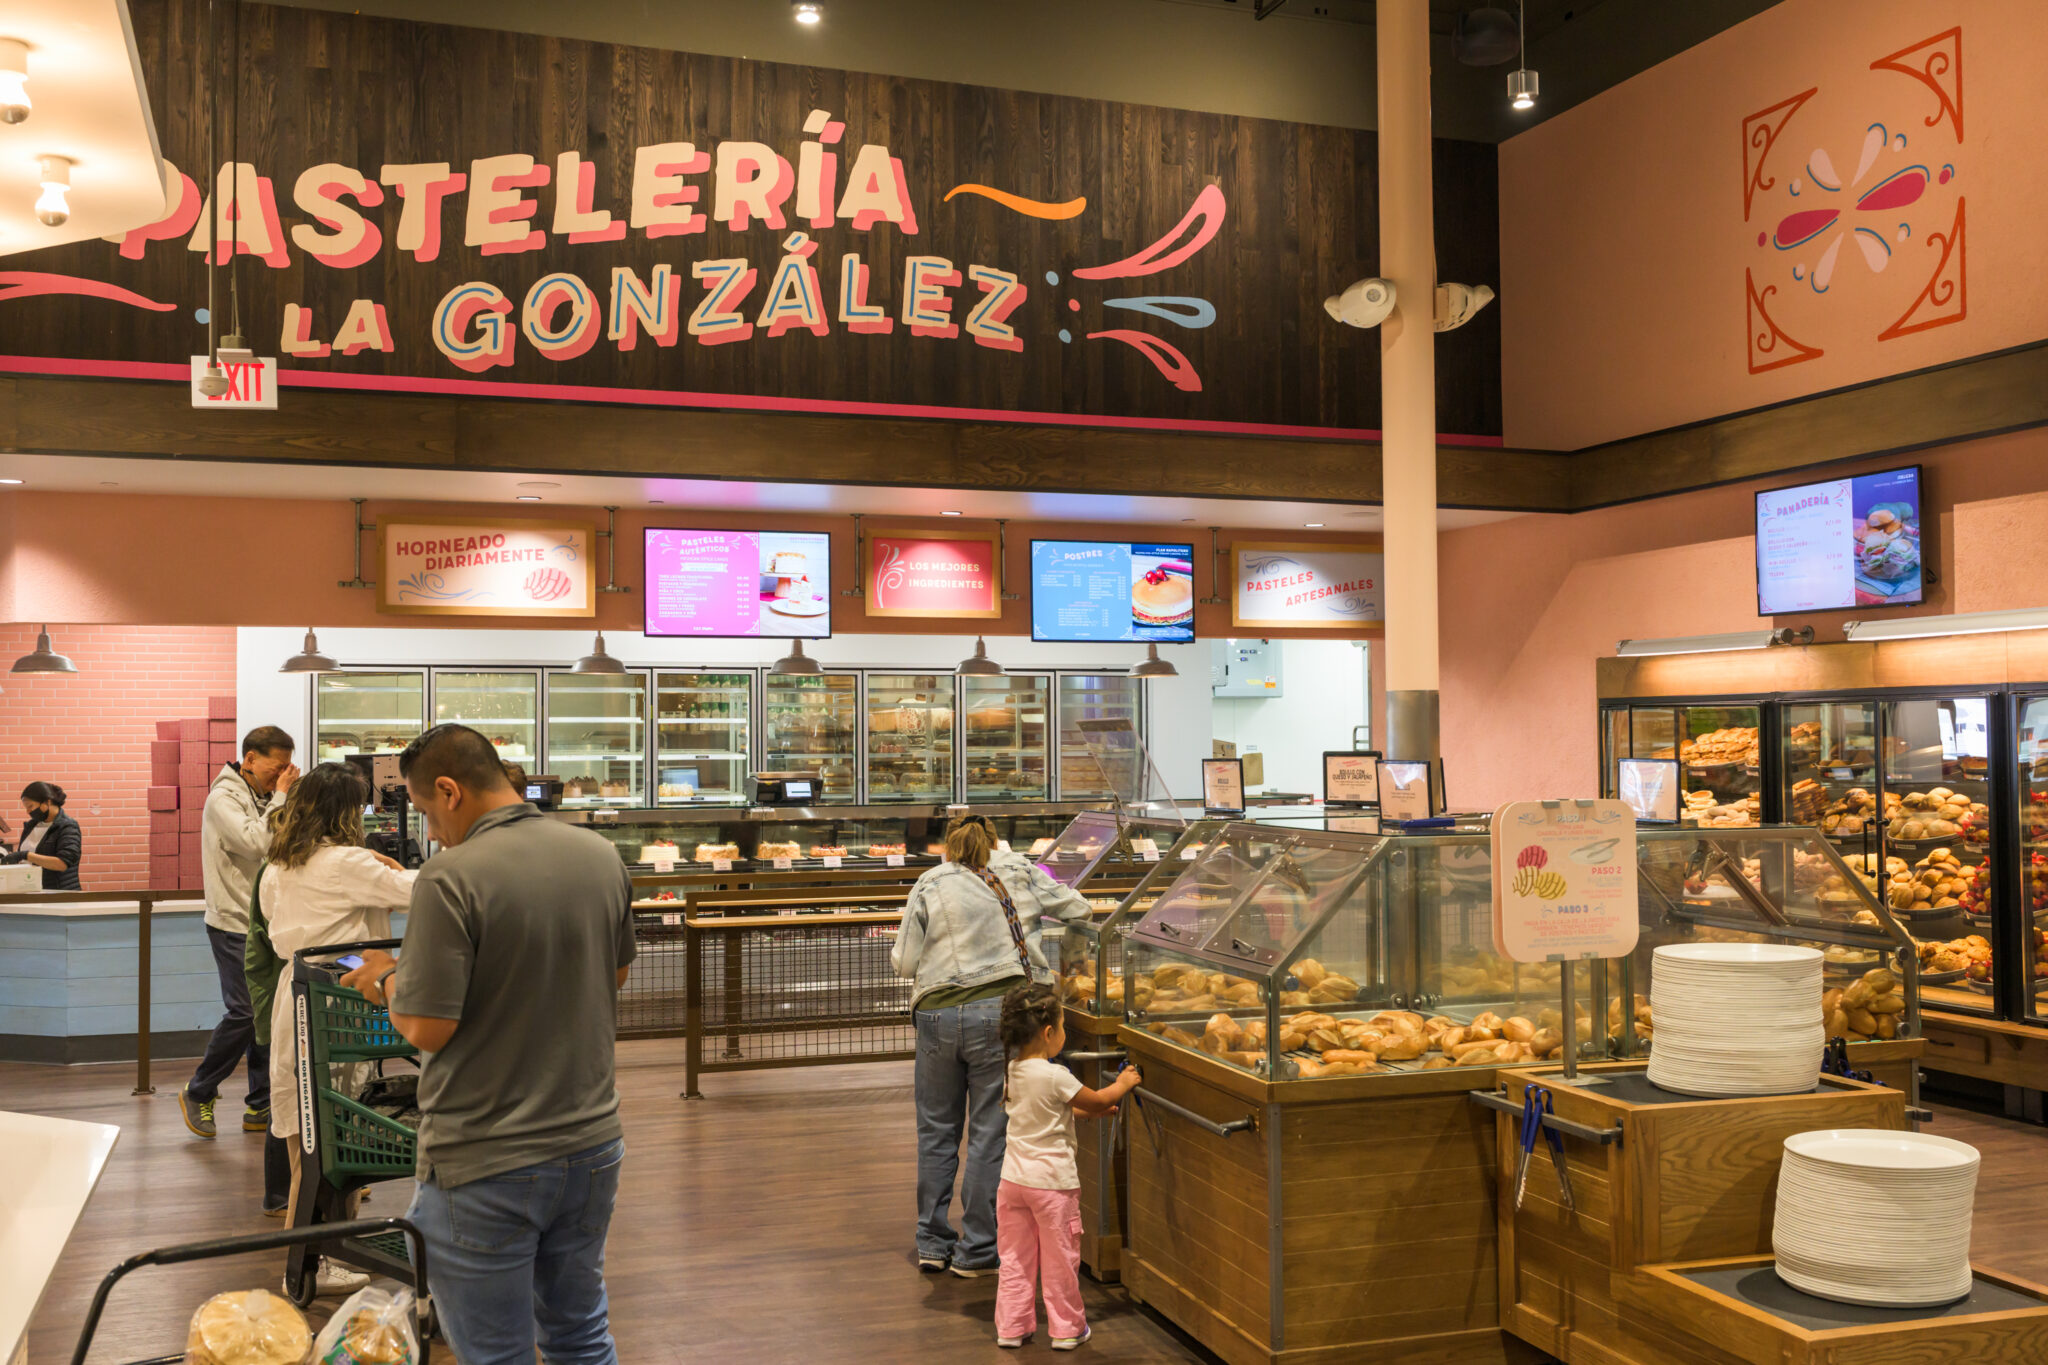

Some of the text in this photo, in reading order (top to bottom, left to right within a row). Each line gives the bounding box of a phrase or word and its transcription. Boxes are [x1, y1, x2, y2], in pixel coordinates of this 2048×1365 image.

[281, 232, 1027, 372] LA GONZÁLEZ
[1777, 492, 1830, 517] PANADERÍA
[397, 534, 506, 556] HORNEADO
[681, 536, 725, 547] PASTELES
[426, 549, 544, 570] DIARIAMENTE
[1064, 550, 1103, 560] POSTRES
[909, 562, 980, 572] LOS MEJORES
[909, 579, 984, 588] INGREDIENTES
[1247, 571, 1314, 592] PASTELES
[1286, 578, 1374, 607] ARTESANALES
[1557, 814, 1580, 823] PASO
[1592, 866, 1622, 875] PASO 2
[1558, 904, 1589, 914] PASO 3
[302, 1060, 310, 1110] NORTHGATE
